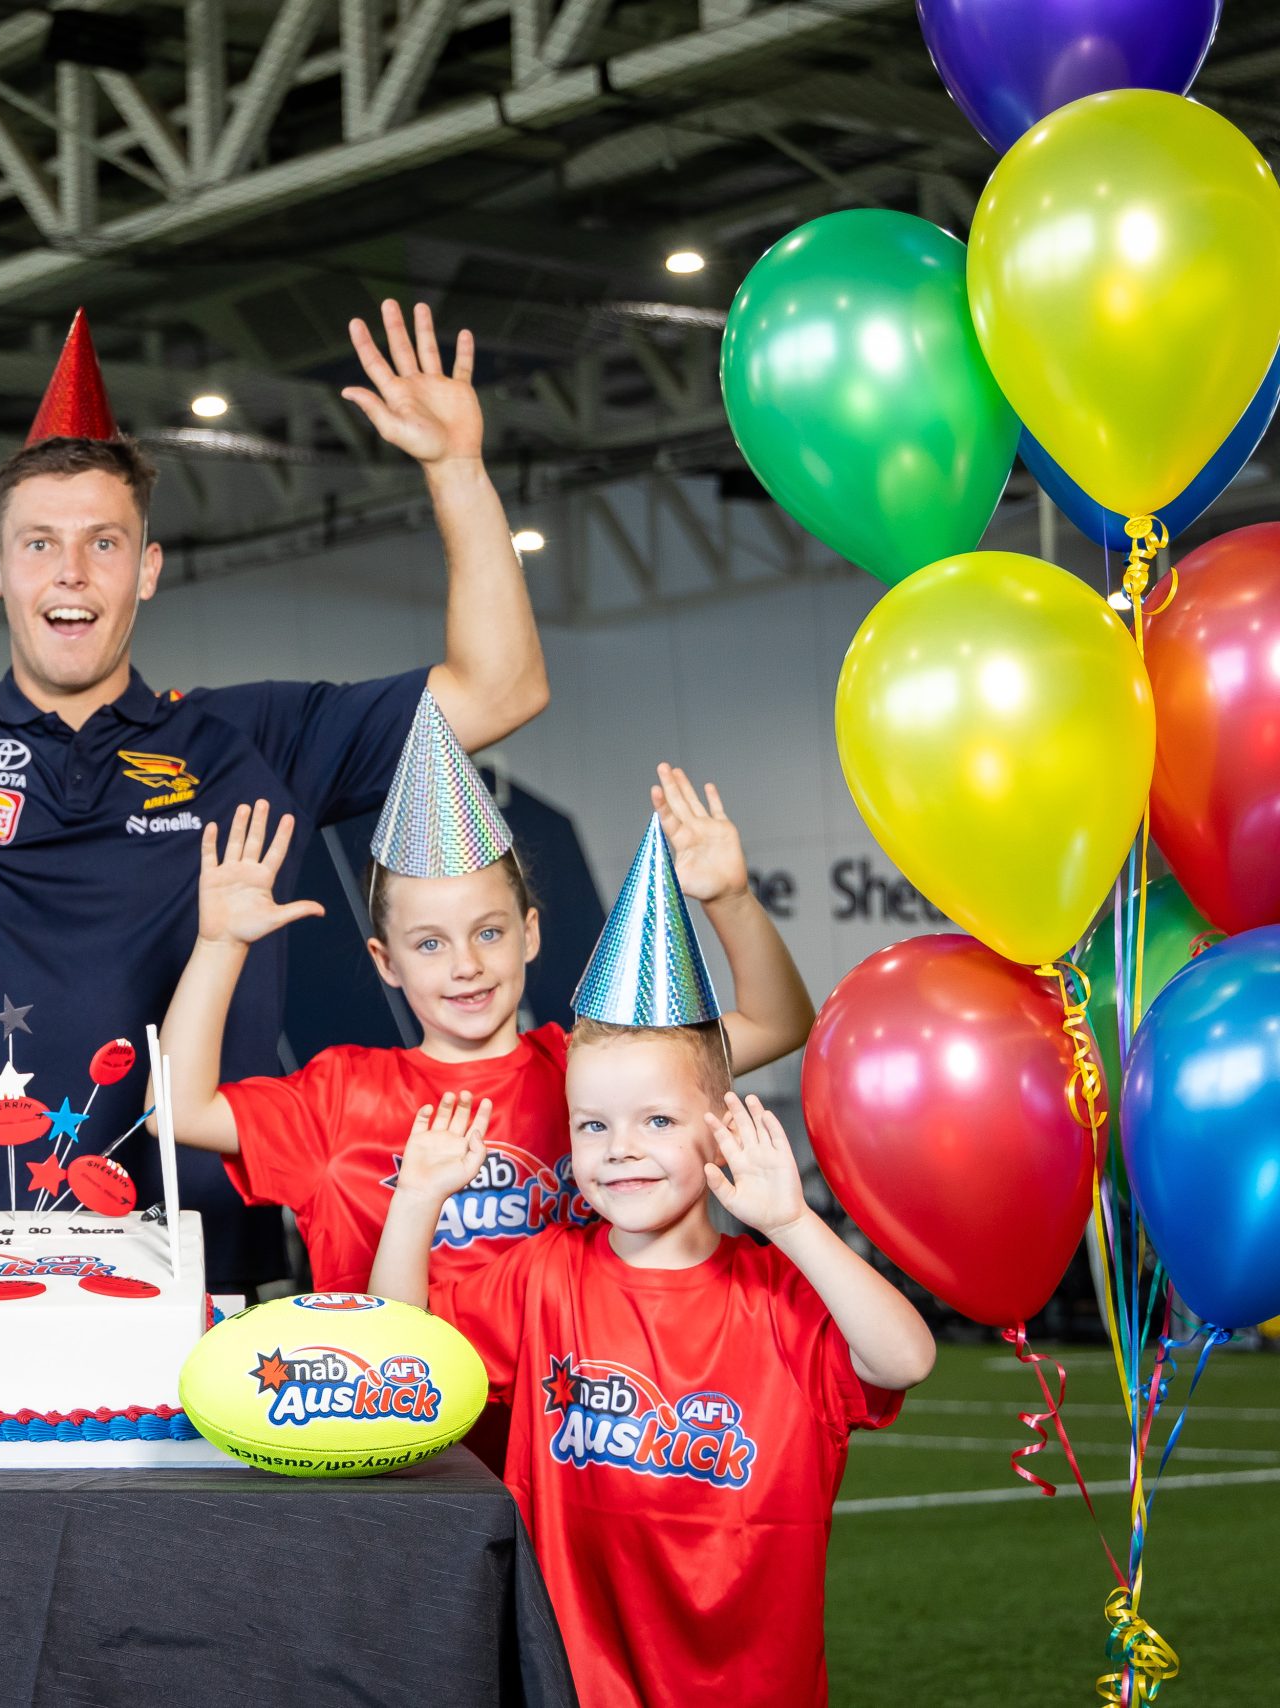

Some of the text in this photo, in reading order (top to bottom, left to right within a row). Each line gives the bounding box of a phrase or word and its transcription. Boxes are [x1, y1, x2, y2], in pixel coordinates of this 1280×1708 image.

[87, 1160, 130, 1188] SHERRIN
[476, 1157, 512, 1189] ab
[436, 1184, 596, 1239] Auskic
[28, 1227, 52, 1235] 30
[68, 1226, 125, 1235] Years
[44, 1256, 96, 1264] AFL
[302, 1293, 379, 1308] AFL
[293, 1355, 346, 1381] nab
[384, 1362, 427, 1379] AFL
[272, 1378, 438, 1421] Auskick
[580, 1380, 632, 1412] nab
[682, 1399, 735, 1425] AFL
[558, 1410, 750, 1480] Auskick
